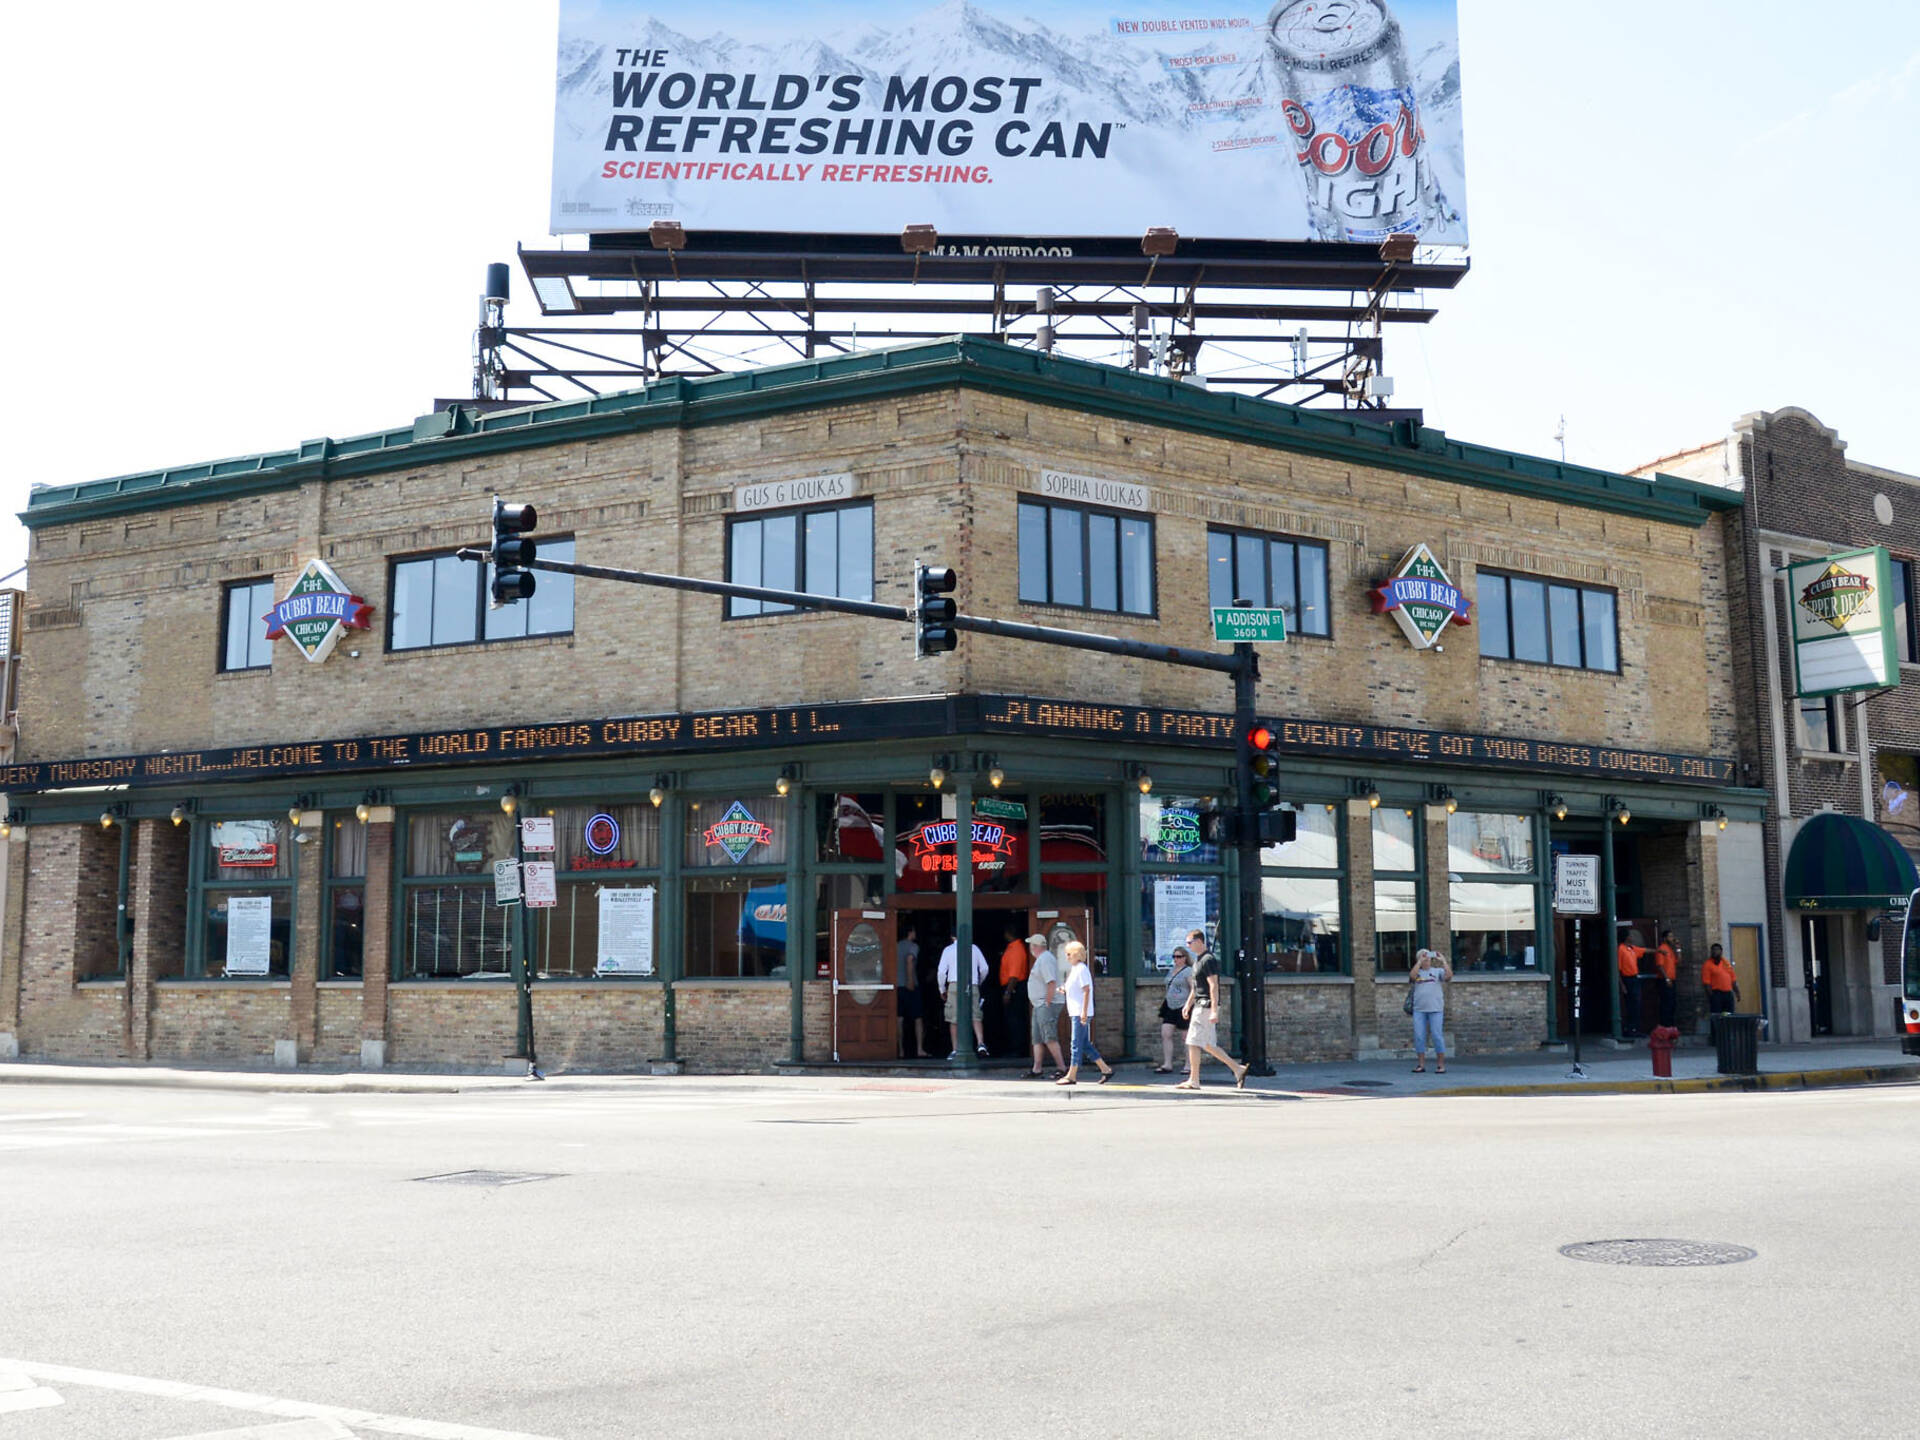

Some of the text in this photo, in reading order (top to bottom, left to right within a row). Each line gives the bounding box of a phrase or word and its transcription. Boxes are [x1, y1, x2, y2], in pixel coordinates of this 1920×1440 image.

[1117, 21, 1138, 33] NEW
[1142, 20, 1177, 32] DOUBLE
[1179, 19, 1208, 30] VENTED
[616, 48, 669, 67] THE
[612, 72, 1042, 114] WORLD'S MOST
[604, 115, 974, 156] REFRESHING
[995, 120, 1112, 158] CAN
[601, 161, 994, 184] SCIENTIFICALLY REFRESHING.
[743, 477, 844, 507] GUS G LOUKAS
[1046, 474, 1143, 507] SOPHIA LOUKAS
[1395, 580, 1458, 609] CUBBY BEAR
[1810, 576, 1861, 595] CUBBY BEAR
[279, 595, 345, 622] CUBBY BEAR
[1412, 607, 1443, 620] CHICAGO
[295, 622, 328, 635] CHICAGO
[1217, 613, 1281, 626] W ADDISON ST
[1234, 628, 1268, 638] 3600 N
[49, 759, 137, 781] THURSDAY
[333, 742, 358, 761] TO
[370, 738, 408, 759] THE
[419, 732, 489, 754] WORLD
[500, 725, 591, 750] FAMOUS
[693, 714, 759, 739] BEAR
[1136, 712, 1150, 733] A
[1161, 714, 1235, 738] PARTY
[1283, 723, 1364, 748] EVENT?
[1373, 730, 1430, 753] WE'VE
[1439, 735, 1474, 756] GOT
[1484, 739, 1529, 760] YOUR
[1537, 744, 1591, 767] BASES
[1681, 759, 1716, 778] CALL
[1722, 763, 1734, 779] 7
[714, 822, 760, 837] CUBBY BEAR
[924, 823, 957, 844] CUBB
[1566, 879, 1586, 887] MUST
